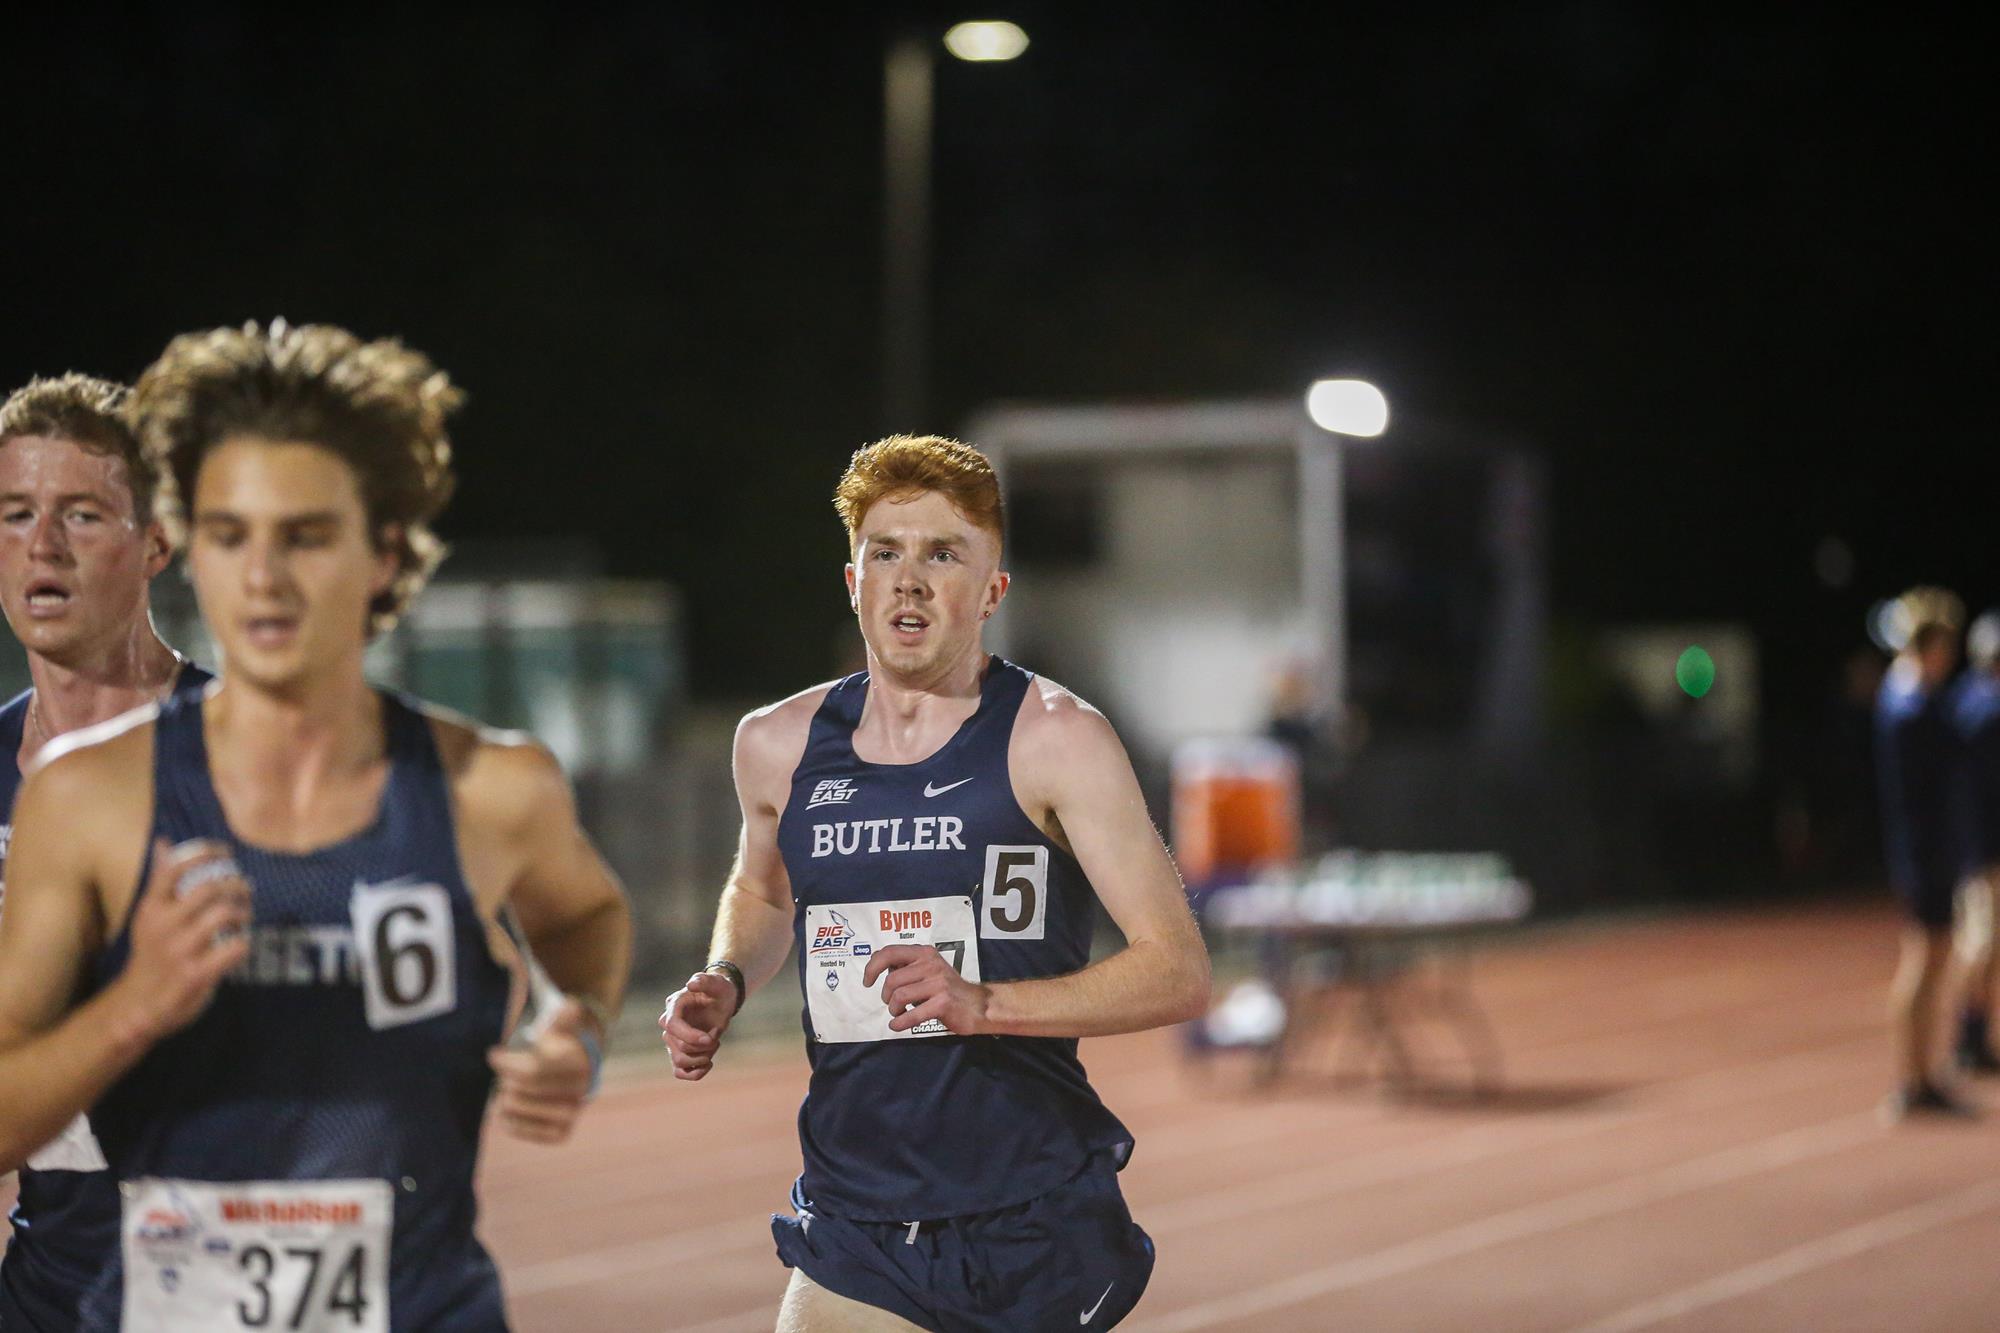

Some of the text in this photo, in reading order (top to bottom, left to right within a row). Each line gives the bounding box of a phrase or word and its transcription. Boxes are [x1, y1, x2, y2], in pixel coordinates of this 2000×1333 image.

[816, 778, 854, 789] BIG
[809, 788, 859, 803] EAST
[811, 816, 966, 858] BUTLER
[990, 851, 1036, 933] 5
[879, 909, 932, 932] Byrne
[816, 926, 844, 937] BIG
[813, 937, 850, 948] EAST
[374, 904, 436, 1007] 6
[839, 959, 846, 968] by
[912, 1023, 948, 1033] CHANG
[238, 1243, 368, 1330] 374
